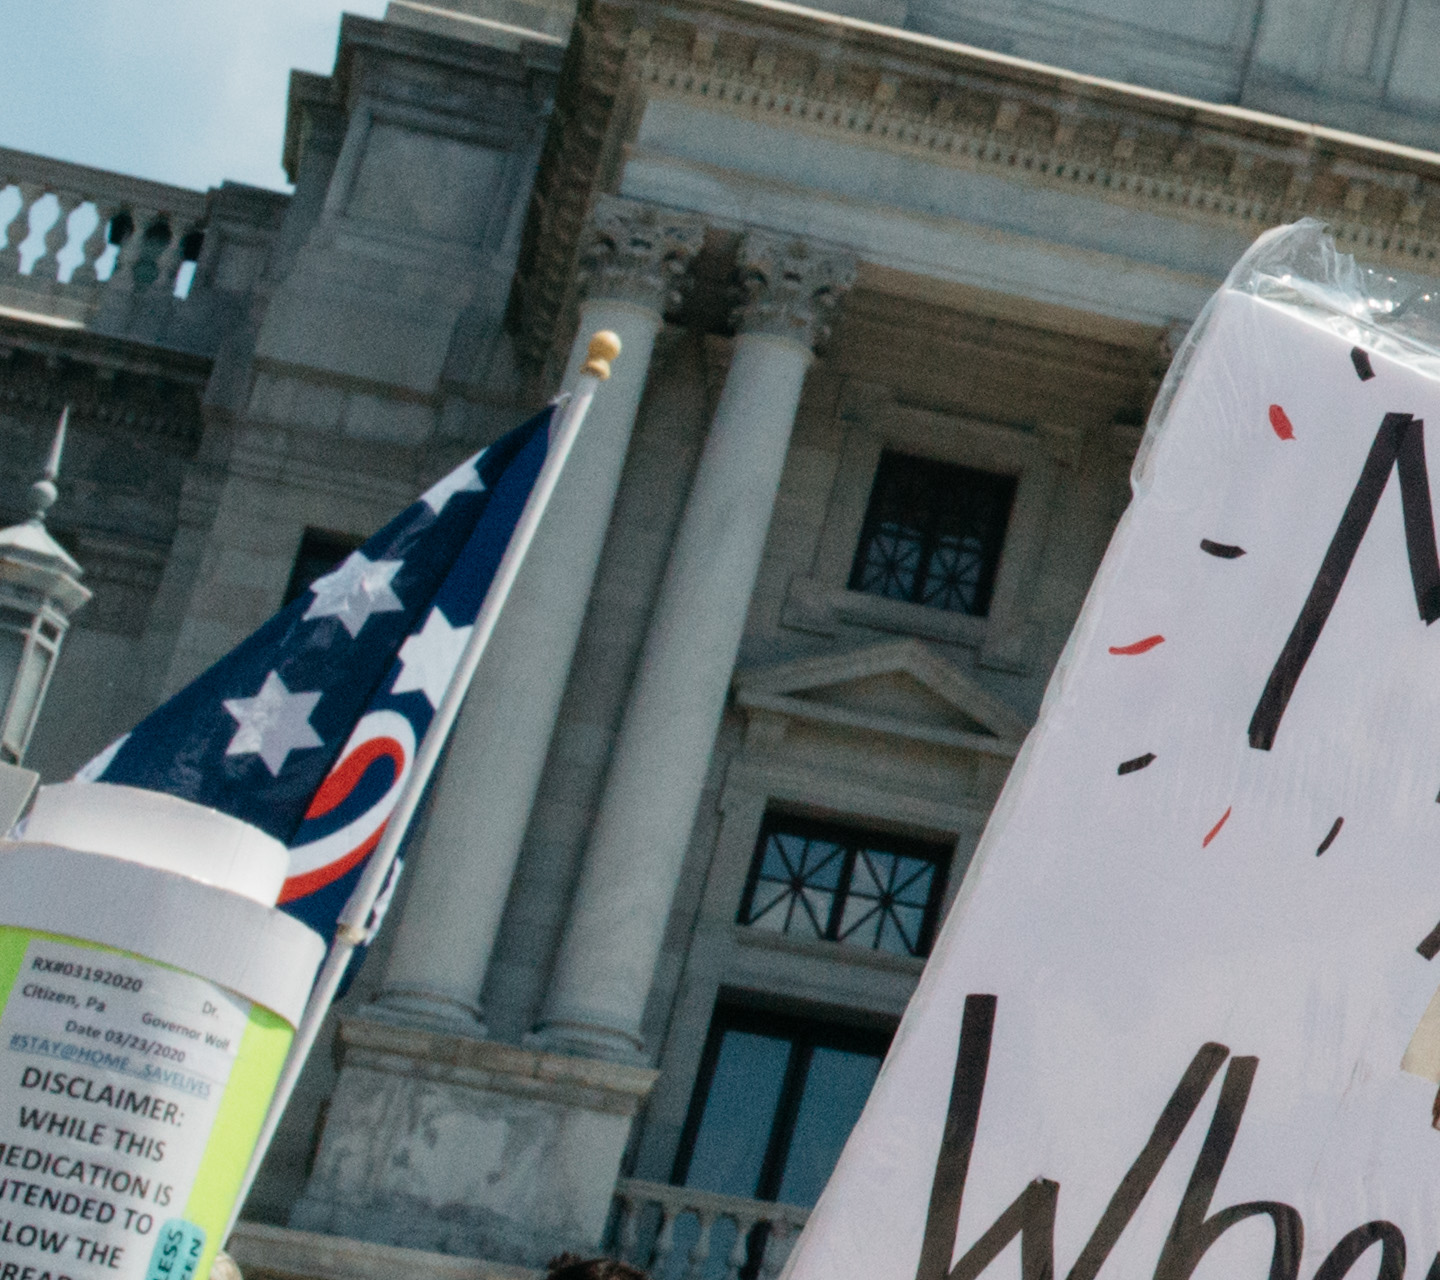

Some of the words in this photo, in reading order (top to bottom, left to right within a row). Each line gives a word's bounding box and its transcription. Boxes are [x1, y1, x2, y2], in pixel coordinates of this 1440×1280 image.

[32, 956, 143, 993] RX#03192020
[22, 983, 81, 1010] Citizen,
[86, 995, 106, 1013] Pa
[202, 1000, 219, 1018] Dr.
[65, 1019, 101, 1039] Date
[105, 1028, 186, 1064] 03/23/2020
[142, 1011, 202, 1041] Governor
[205, 1031, 230, 1051] Wolf
[20, 1066, 185, 1127] DISCLAIMER:
[19, 1106, 105, 1146] WHILE
[114, 1127, 166, 1163] THIS
[154, 1182, 173, 1207] IS
[124, 1207, 154, 1236] TO
[76, 1236, 126, 1270] THE
